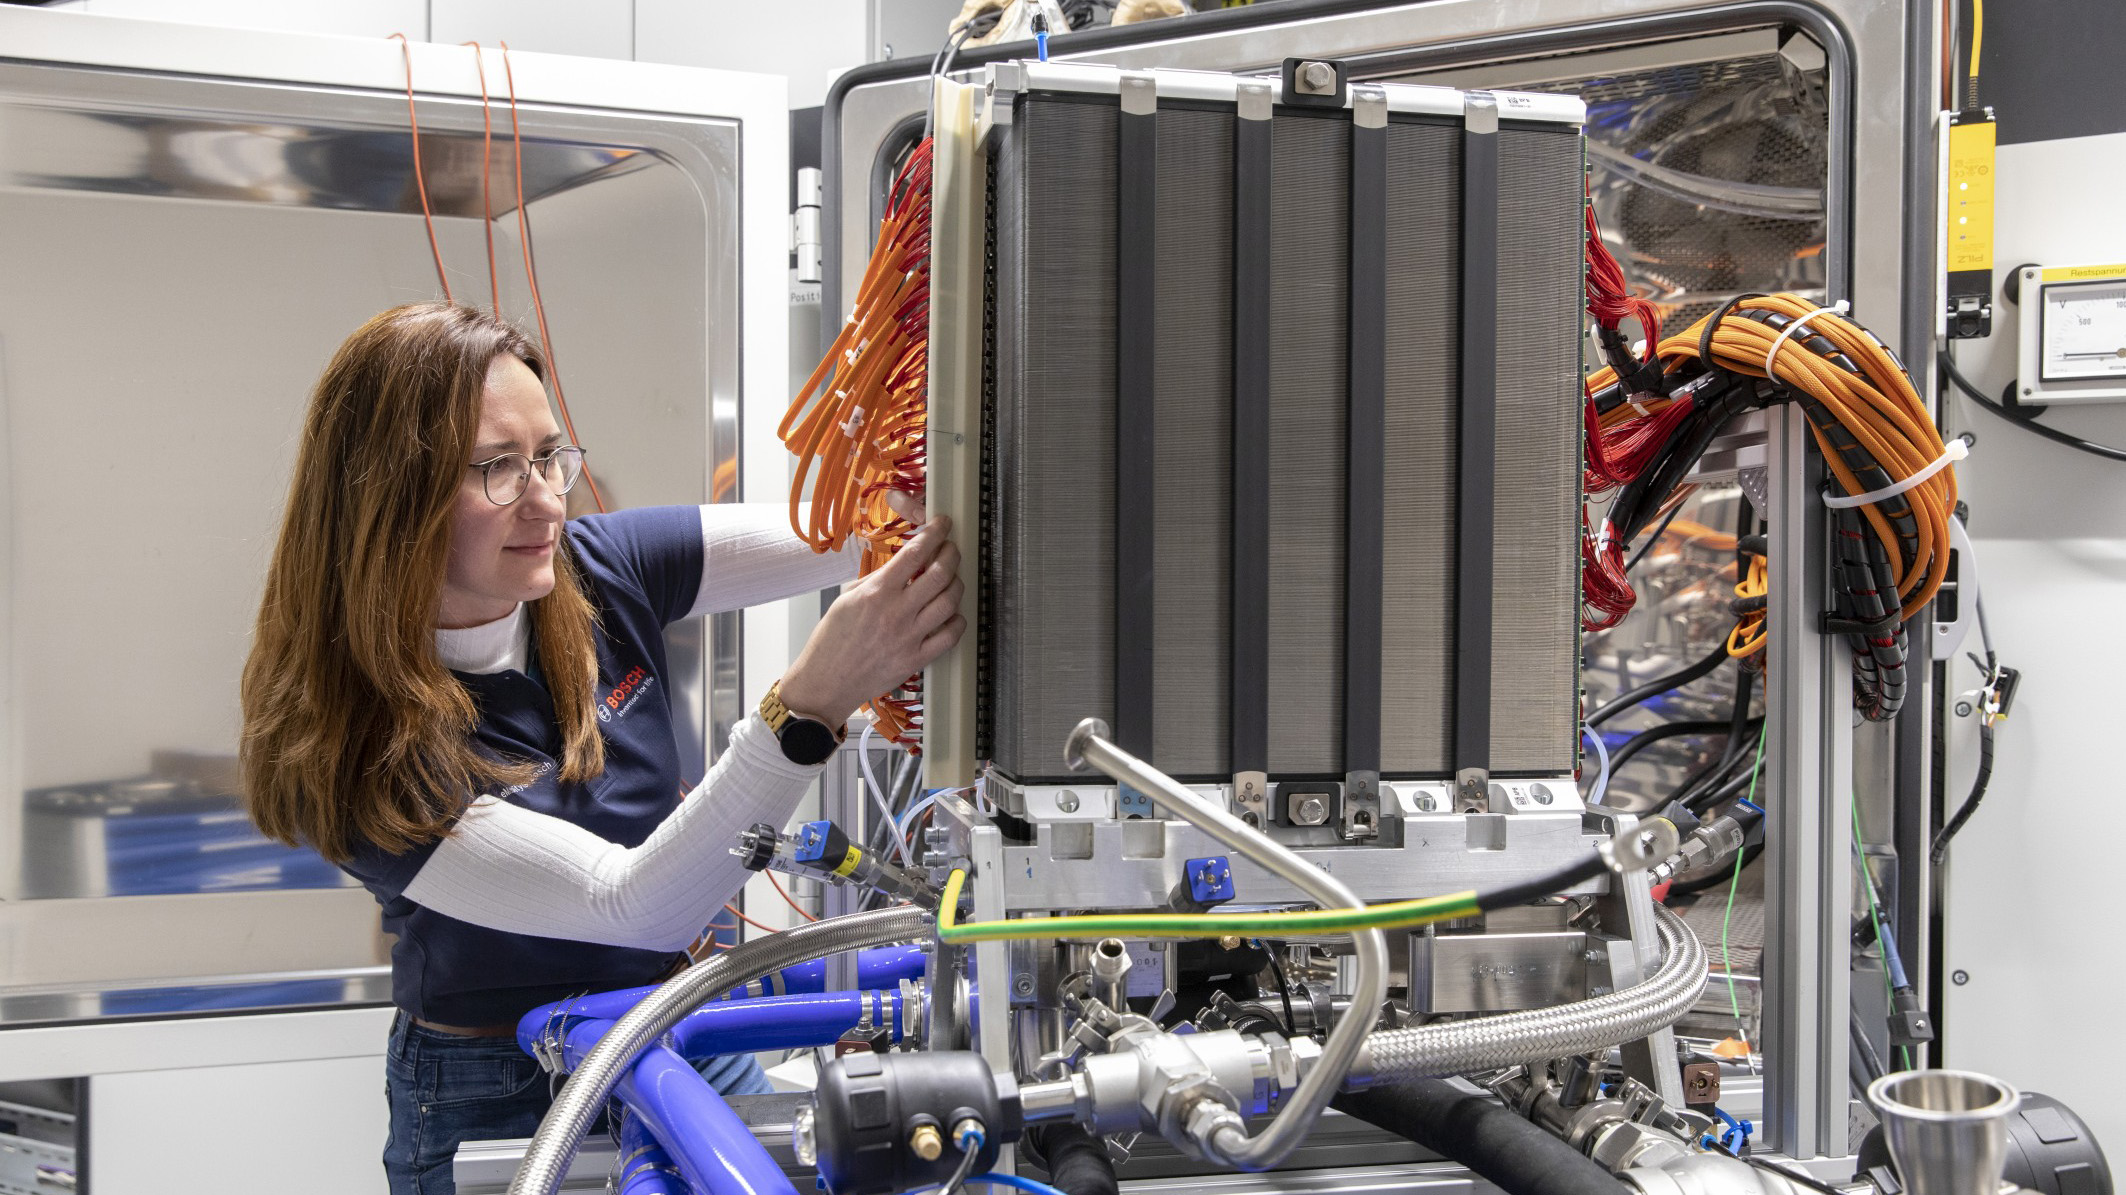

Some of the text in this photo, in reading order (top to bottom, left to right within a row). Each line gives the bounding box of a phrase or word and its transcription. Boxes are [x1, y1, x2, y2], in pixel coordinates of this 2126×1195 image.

[1957, 254, 1984, 264] PILZ
[2059, 299, 2067, 309] V
[606, 665, 647, 709] BOSCH
[636, 684, 647, 696] for
[1592, 839, 1599, 848] 2
[1025, 857, 1030, 866] 1
